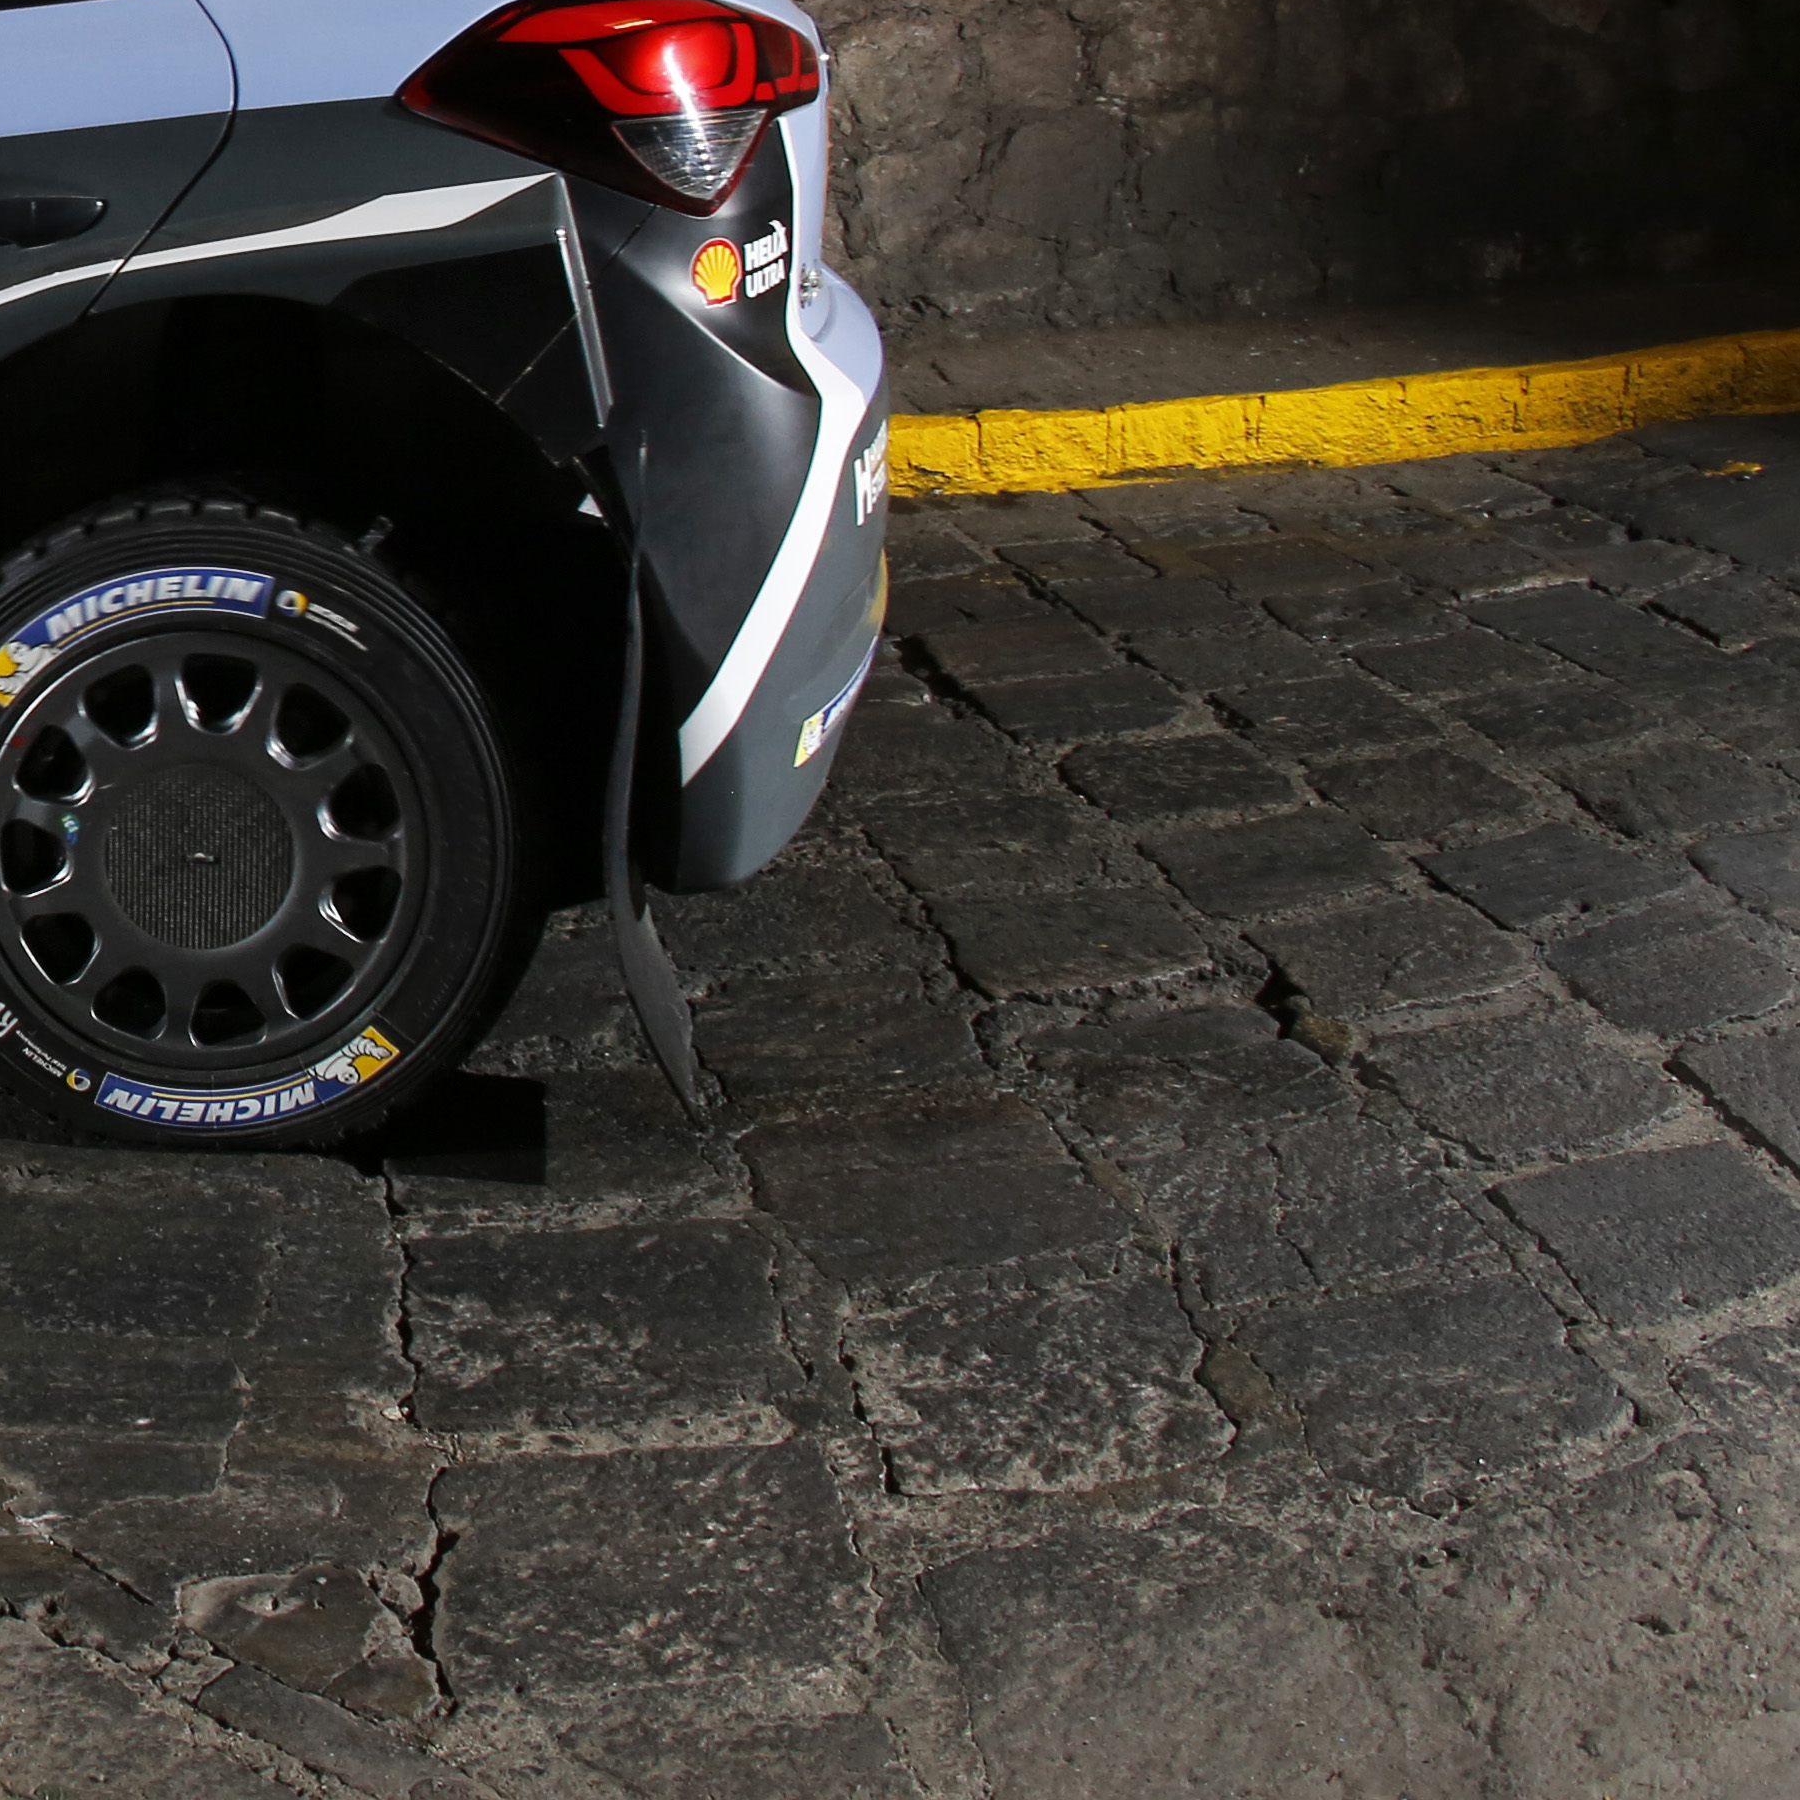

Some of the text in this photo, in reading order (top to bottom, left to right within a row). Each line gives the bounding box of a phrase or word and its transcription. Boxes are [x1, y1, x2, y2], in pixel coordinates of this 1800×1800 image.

[743, 220, 789, 272] HELIX
[745, 258, 786, 298] ULTRA
[45, 571, 266, 644] MICHELIN
[102, 1079, 315, 1123] MICHELIN
